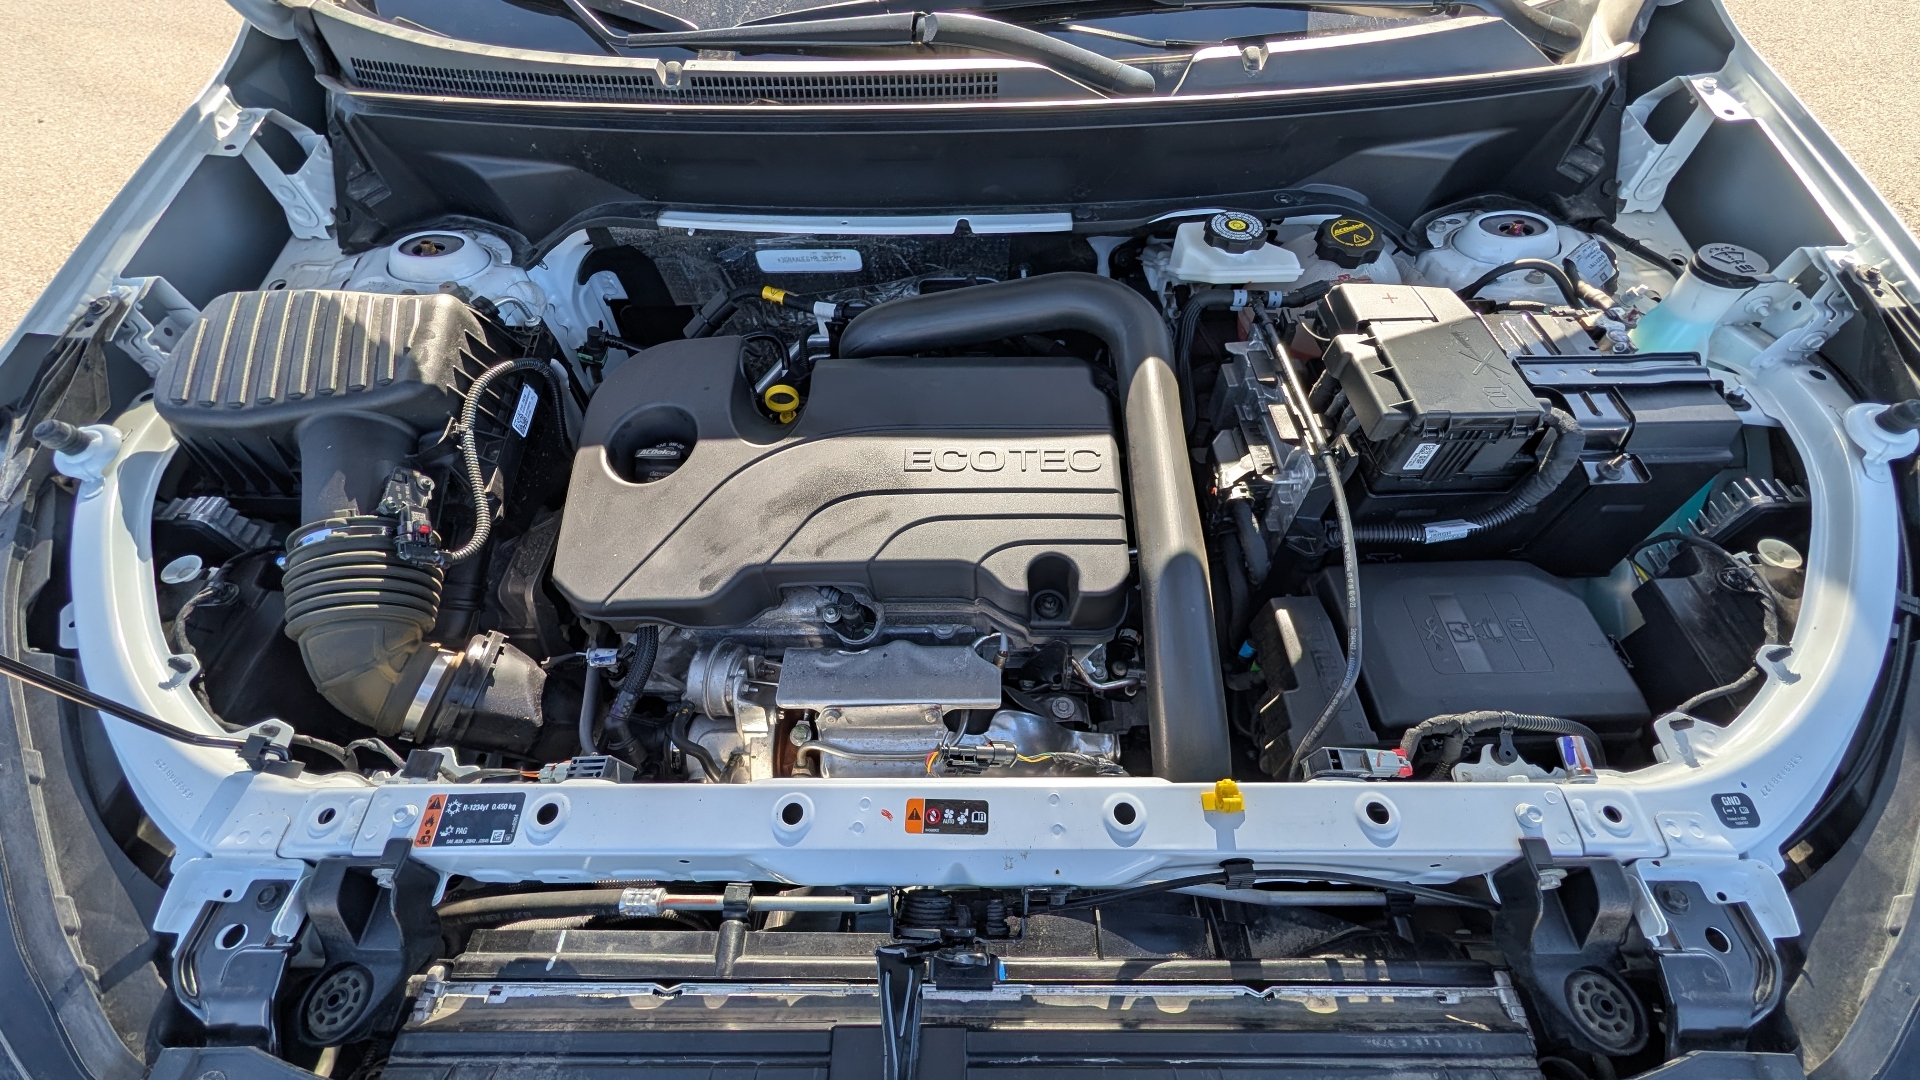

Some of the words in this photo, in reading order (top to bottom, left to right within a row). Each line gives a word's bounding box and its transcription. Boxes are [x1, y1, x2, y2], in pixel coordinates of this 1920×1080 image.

[904, 448, 1101, 472] ECOTEC
[1721, 796, 1741, 806] GND
[462, 804, 489, 812] R-1234yf
[508, 803, 516, 811] kg
[455, 827, 468, 835] PAG
